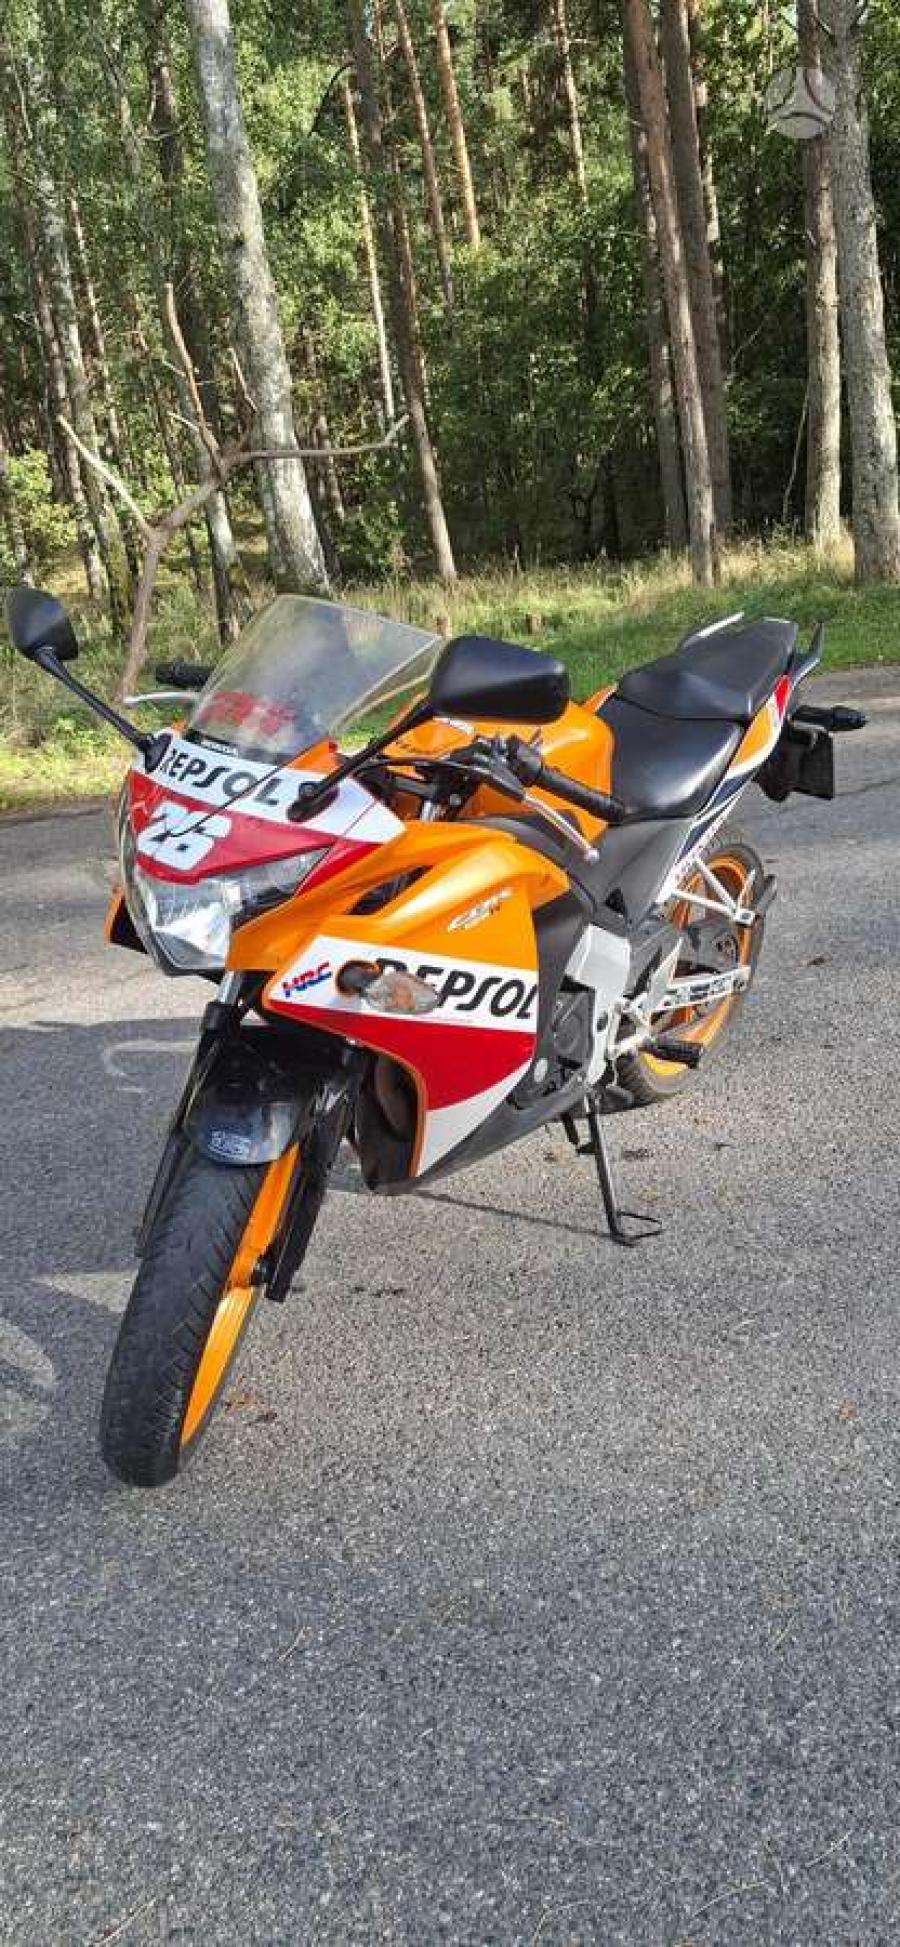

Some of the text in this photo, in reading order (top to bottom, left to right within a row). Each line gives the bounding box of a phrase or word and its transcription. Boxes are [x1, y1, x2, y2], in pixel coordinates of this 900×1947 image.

[159, 748, 283, 806] REPSOL
[138, 801, 232, 871] 26
[282, 961, 332, 998] HRC
